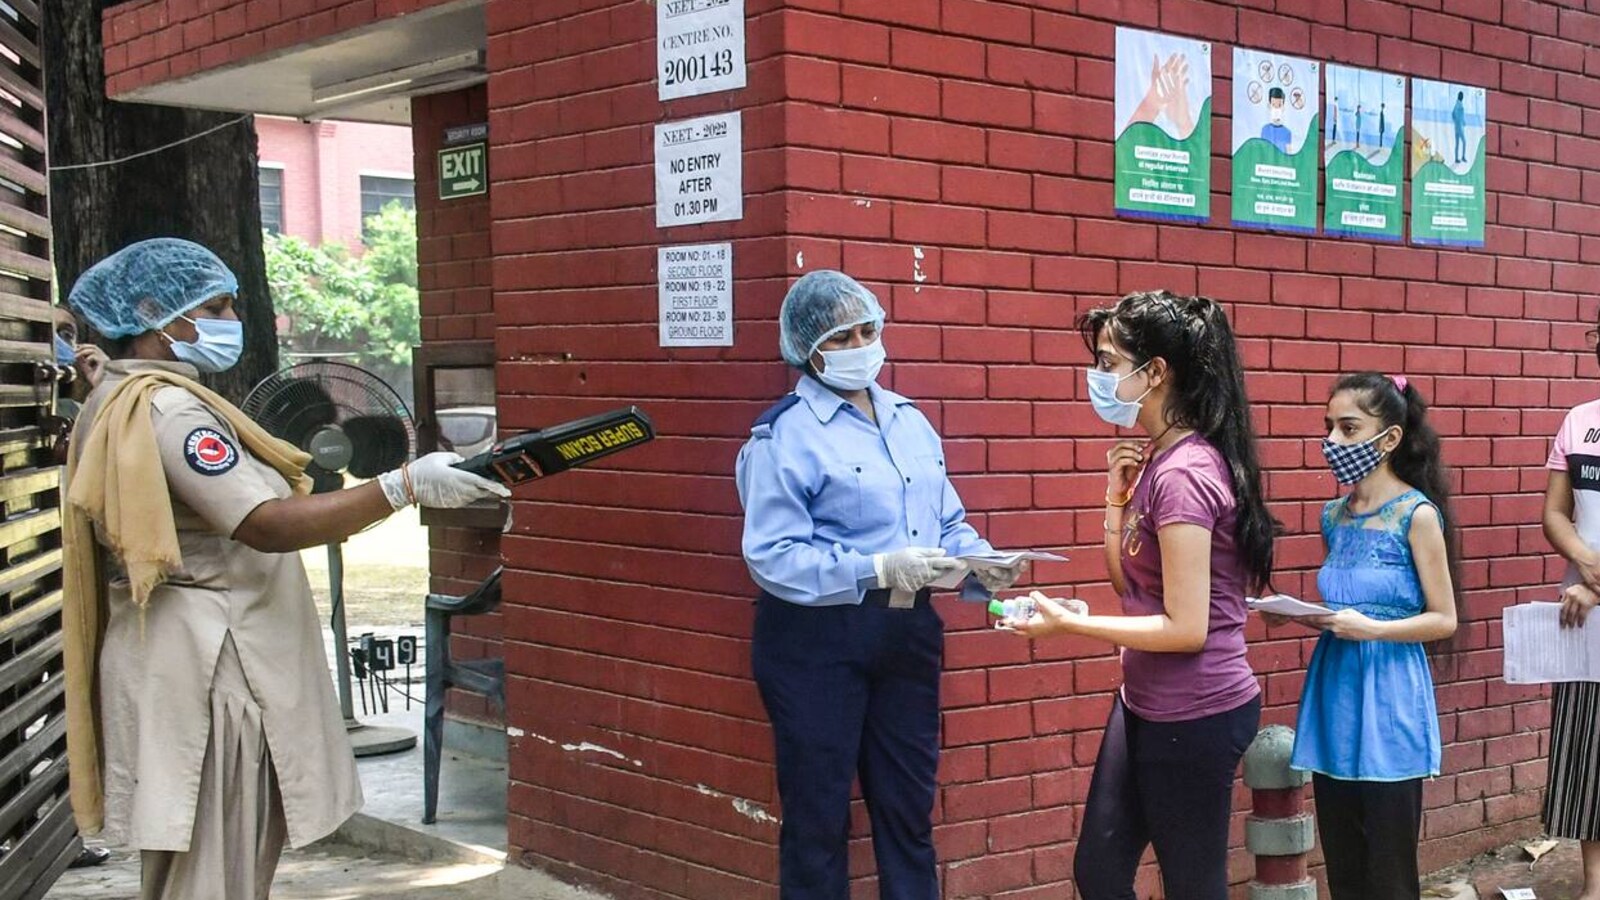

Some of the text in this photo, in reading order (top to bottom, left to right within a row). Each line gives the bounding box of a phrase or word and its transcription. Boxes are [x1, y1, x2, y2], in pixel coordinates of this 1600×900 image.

[666, 0, 695, 16] NEET
[663, 25, 733, 50] CENTRE NO.
[665, 48, 733, 86] 200143
[663, 127, 693, 145] NEET
[703, 121, 727, 138] 2022
[442, 149, 481, 179] EXIT
[670, 153, 721, 174] NO ENTRY
[679, 177, 712, 194] AFTER
[674, 198, 718, 217] 01.30 PM
[666, 251, 686, 262] ROOM
[702, 250, 710, 260] 01
[717, 249, 725, 260] 18
[668, 265, 723, 277] SECOND FLOOR
[665, 281, 687, 292] ROOM
[703, 281, 711, 291] 19
[717, 280, 726, 291] 22
[672, 295, 718, 307] FIRST FLOOR
[666, 311, 687, 322] ROOM
[703, 311, 711, 322] 23
[717, 311, 726, 321] 30
[669, 326, 723, 337] GROUND FLOOR
[556, 422, 643, 460] SUPER SCANN
[376, 646, 389, 667] 4
[400, 639, 413, 663] 9
